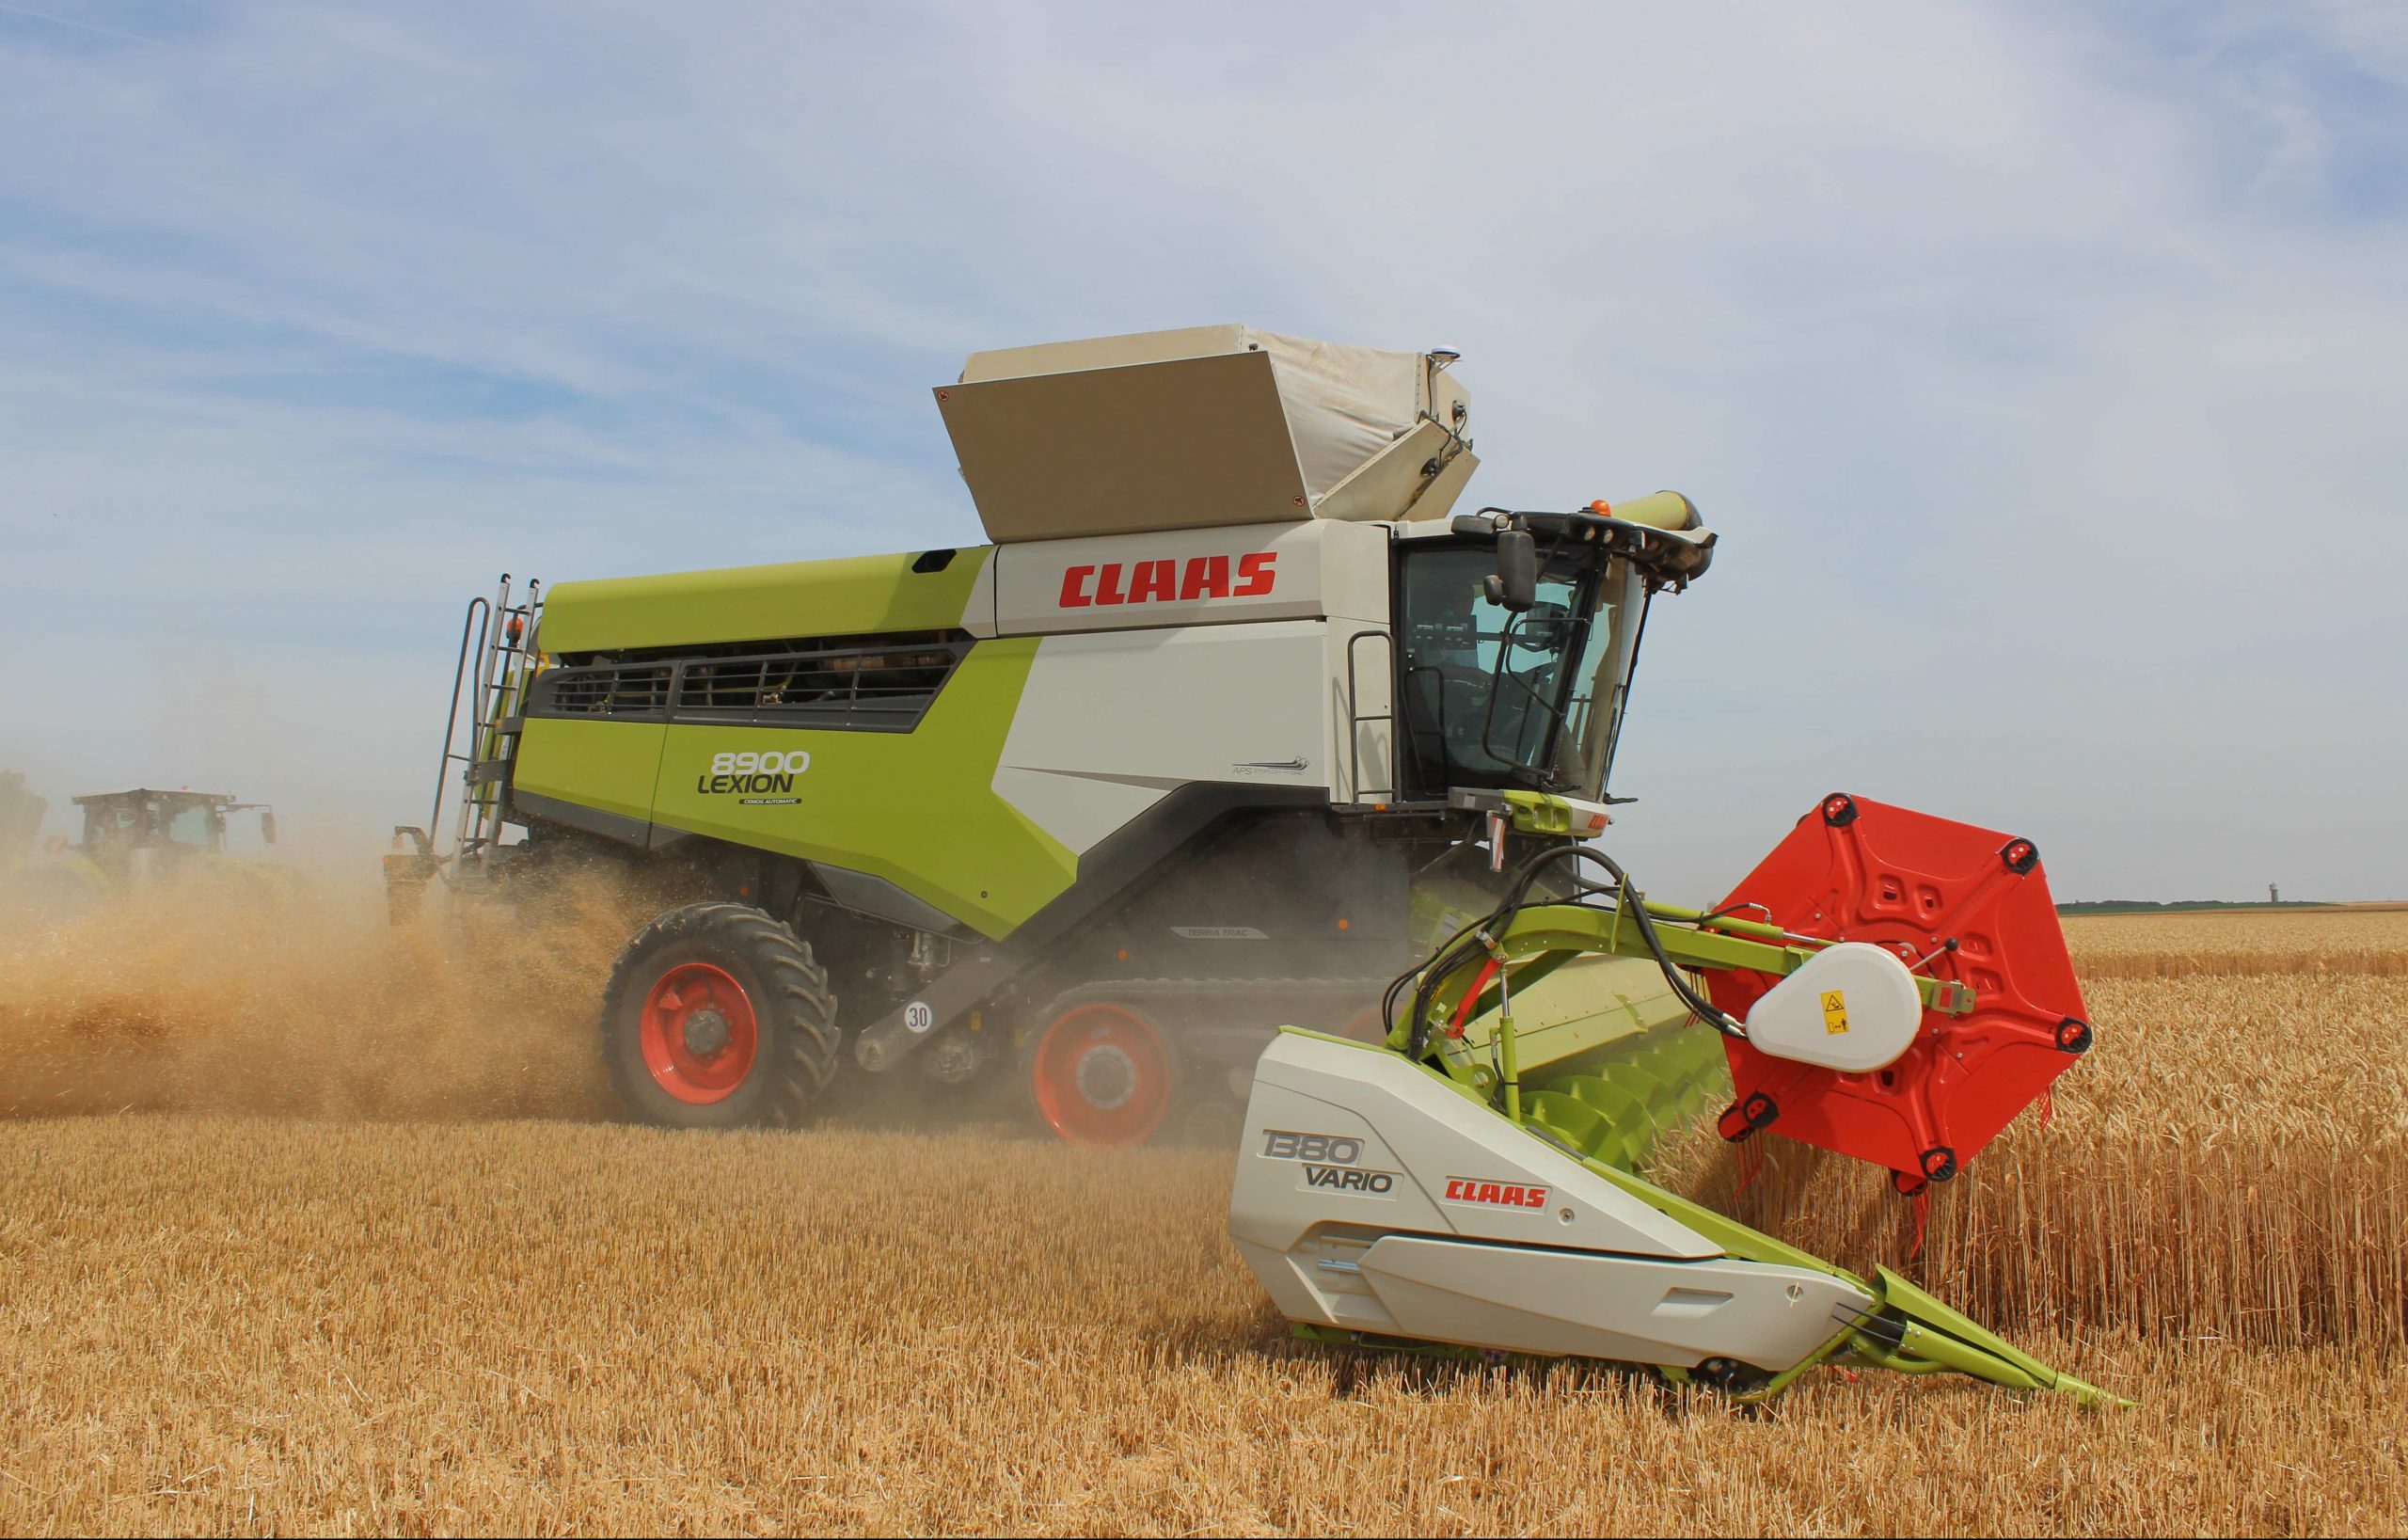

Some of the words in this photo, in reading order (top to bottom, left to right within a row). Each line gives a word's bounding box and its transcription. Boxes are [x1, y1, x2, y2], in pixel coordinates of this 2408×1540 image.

[1058, 552, 1277, 608] CLAAS
[711, 751, 810, 775] 8900
[697, 773, 795, 794] LEXION
[1188, 929, 1220, 937] TERRA
[1223, 929, 1249, 937] TRAC
[909, 1007, 927, 1027] 30
[1306, 1167, 1393, 1193] VARIO
[1445, 1181, 1546, 1208] CLAAS
